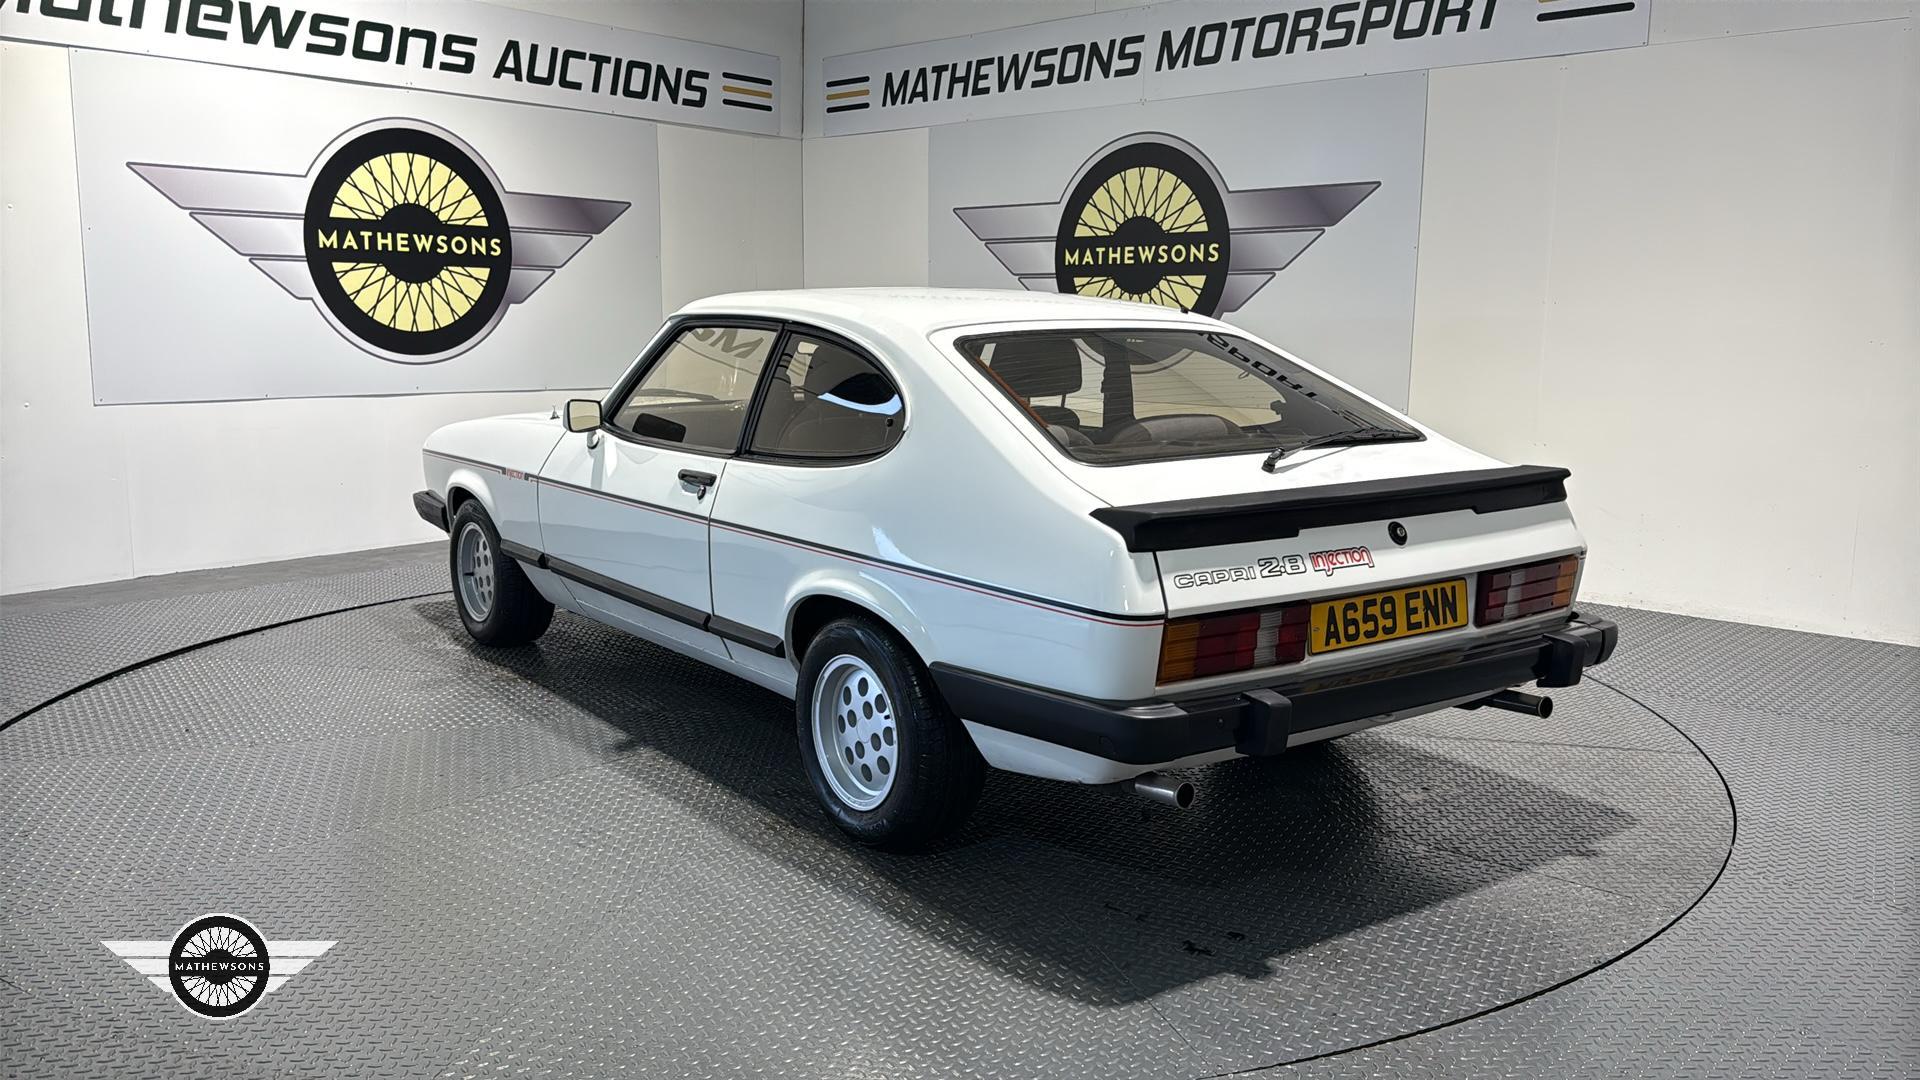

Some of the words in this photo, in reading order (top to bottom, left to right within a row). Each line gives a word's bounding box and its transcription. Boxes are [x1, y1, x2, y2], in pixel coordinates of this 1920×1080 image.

[0, 0, 477, 74] hewsons
[493, 40, 710, 108] AUCTIONS
[881, 35, 1145, 107] MATHEWSONS
[318, 229, 502, 256] MATHEWSONS
[1065, 243, 1219, 266] MATHEWSONS
[1174, 566, 1256, 588] CAPRI
[1258, 554, 1306, 578] 2.8
[1325, 596, 1397, 646] A659
[1405, 585, 1457, 631] ENN
